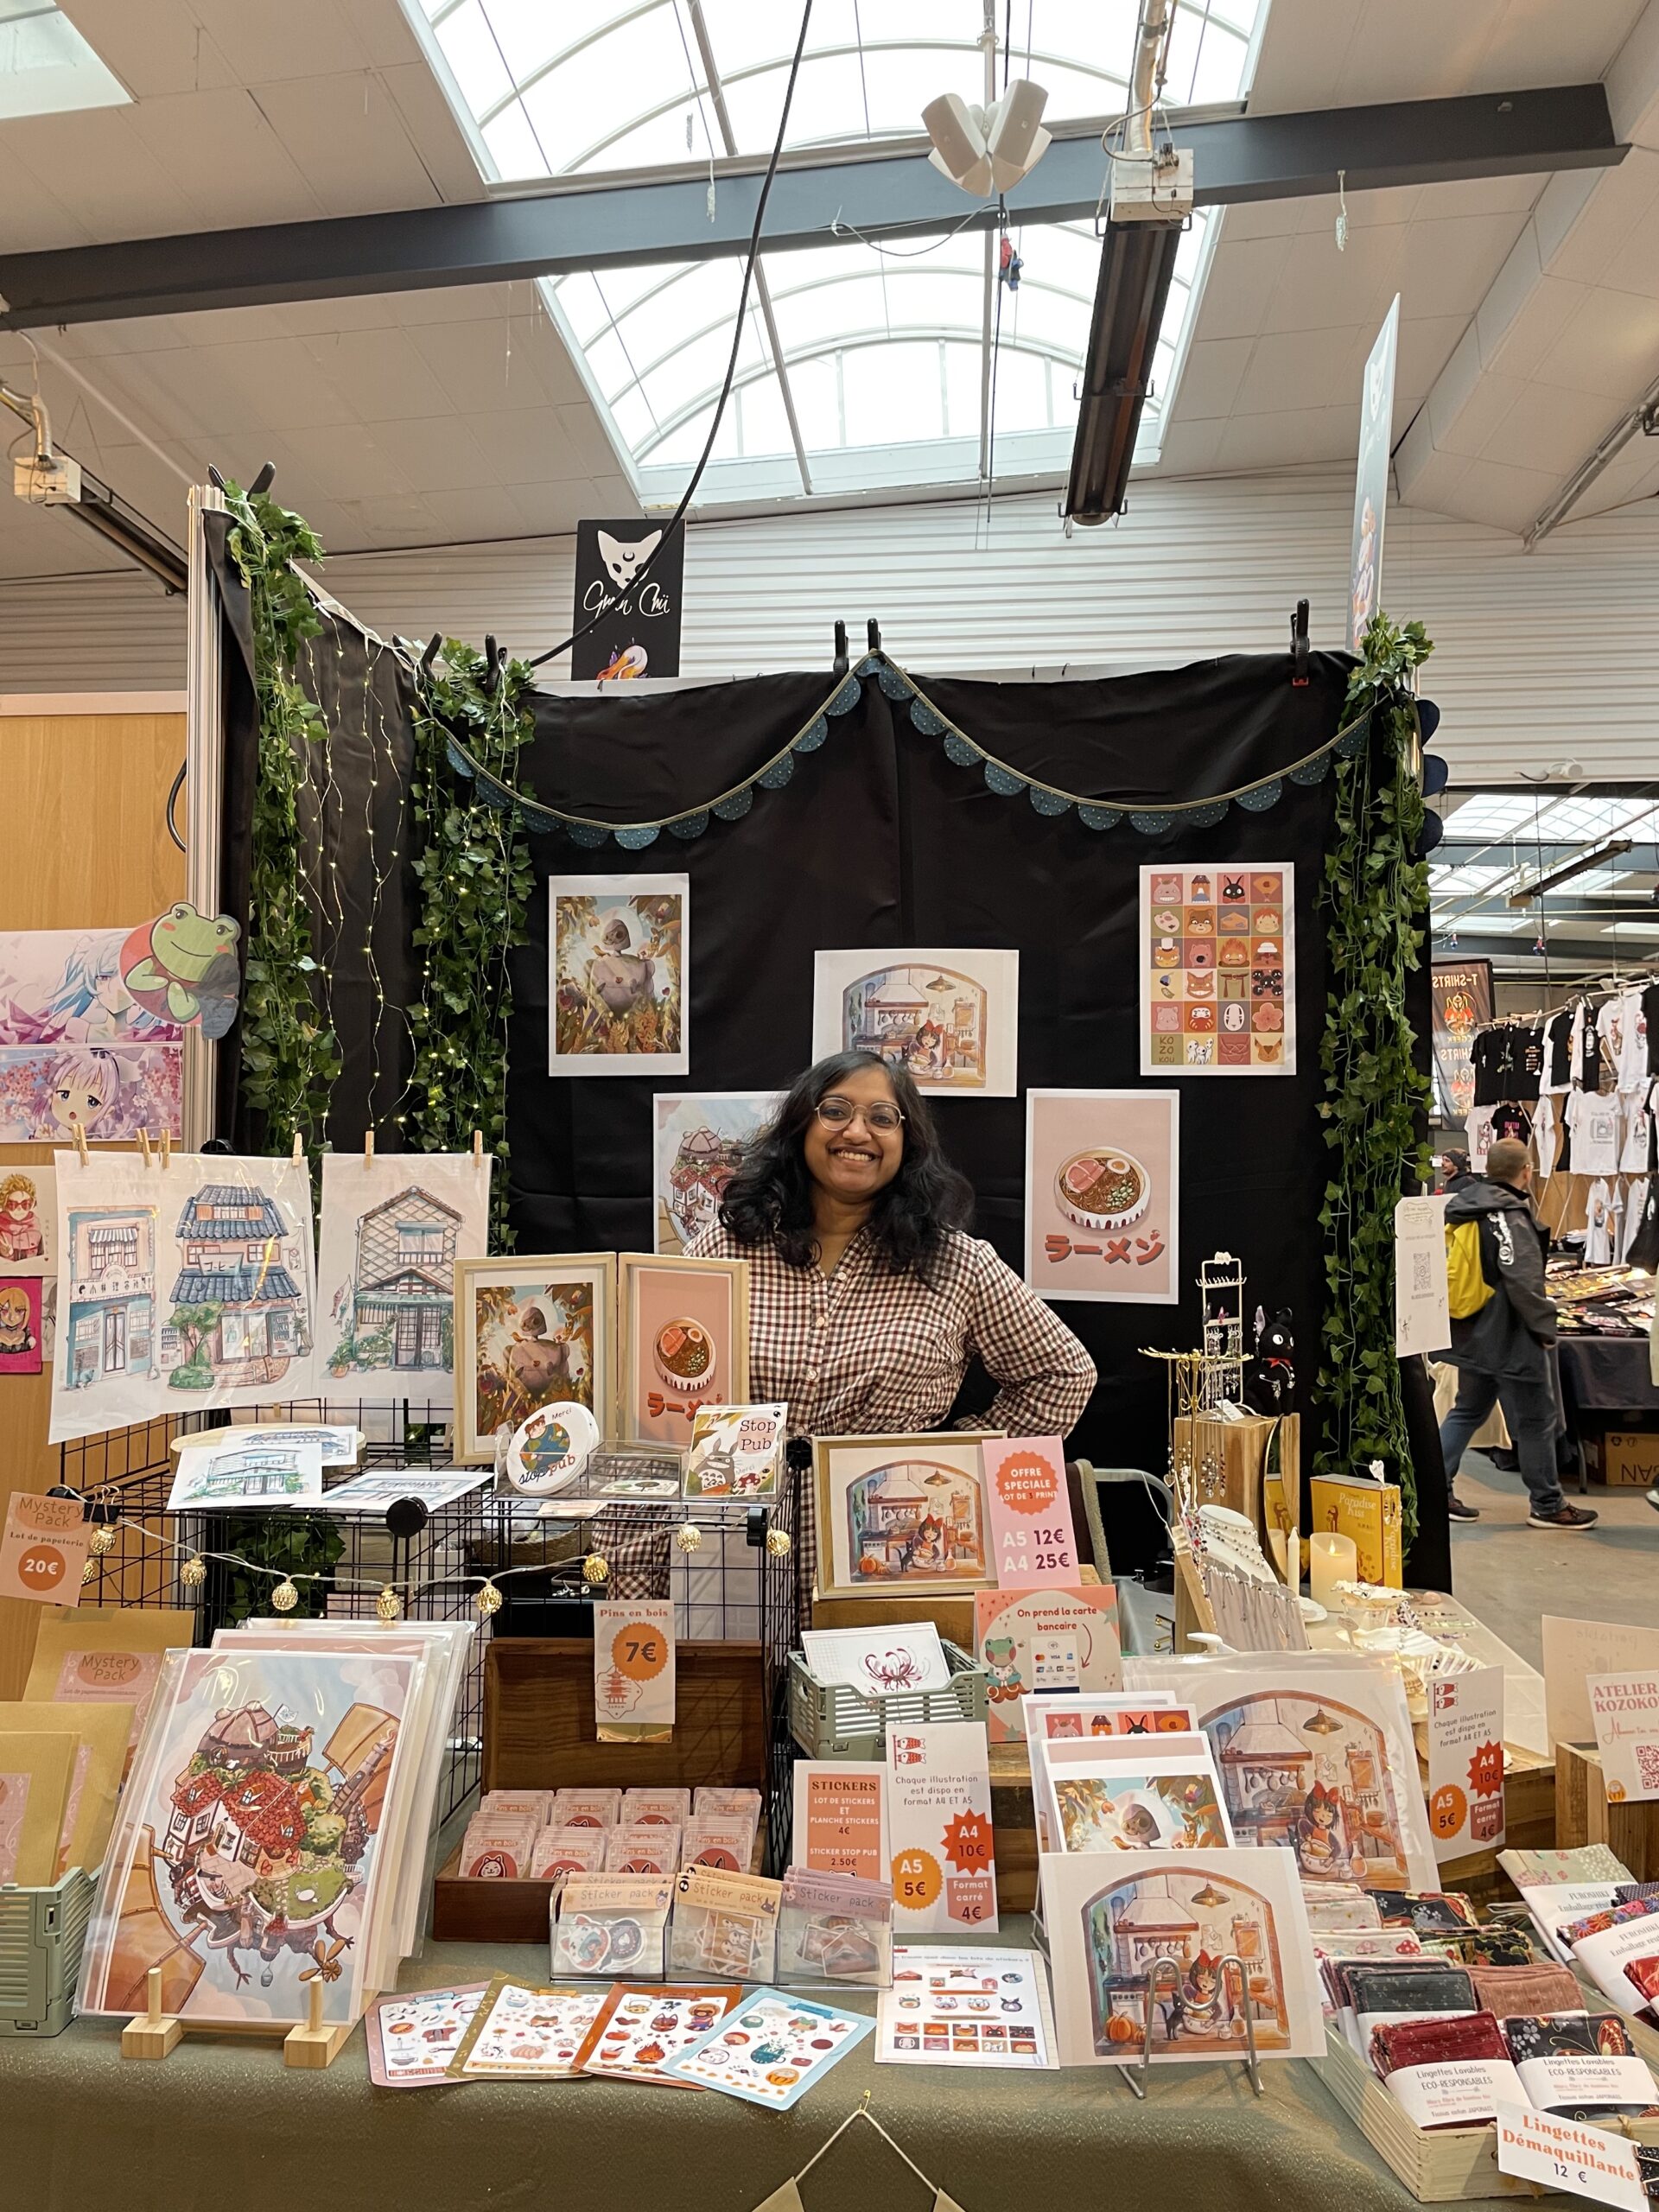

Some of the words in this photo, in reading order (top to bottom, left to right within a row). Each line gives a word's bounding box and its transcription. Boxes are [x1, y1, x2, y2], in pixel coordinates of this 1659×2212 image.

[551, 1407, 572, 1421] Merci
[740, 1420, 777, 1435] Stop
[741, 1438, 772, 1451] Pub
[518, 1468, 548, 1485] stop
[547, 1453, 576, 1477] pub
[1010, 1468, 1042, 1478] OFFRE
[1004, 1478, 1051, 1491] SPECIALE
[19, 1497, 84, 1516] Mystery
[1338, 1492, 1376, 1510] Paradise
[1347, 1504, 1365, 1518] Kiss
[35, 1512, 71, 1528] Pack
[10, 1531, 25, 1540] Lot
[28, 1533, 38, 1541] de
[41, 1536, 84, 1548] papeterie
[1002, 1531, 1027, 1548] A5
[1033, 1529, 1065, 1546] 12€
[24, 1559, 59, 1575] 20€
[1004, 1555, 1028, 1573] A4
[1035, 1552, 1070, 1570] 25€
[646, 1608, 668, 1618] bois
[1017, 1609, 1031, 1618] On
[1033, 1607, 1059, 1618] prend
[1062, 1607, 1071, 1616] la
[1072, 1606, 1097, 1615] carte
[1037, 1622, 1077, 1631] bancaire
[626, 1642, 657, 1662] 7€
[81, 1655, 139, 1671] Mystery
[93, 1668, 126, 1681] Pack
[1593, 1682, 1658, 1699] ATELIER
[1595, 1697, 1659, 1713] KOZOKO
[1434, 1719, 1458, 1730] Chaque
[1459, 1709, 1497, 1723] illustration
[1458, 1724, 1476, 1736] dispo
[1440, 1737, 1462, 1748] format
[1473, 1731, 1481, 1739] ET
[1484, 1728, 1491, 1737] A5
[1480, 1753, 1495, 1768] A4
[895, 1776, 926, 1785] Chaque
[930, 1775, 978, 1783] illustration
[1478, 1770, 1498, 1784] 10€
[812, 1781, 876, 1791] STICKERS
[928, 1786, 950, 1796] dispo
[904, 1797, 931, 1806] format
[1436, 1793, 1453, 1810] A5
[1474, 1800, 1500, 1814] Format
[1440, 1812, 1455, 1829] 5€
[1477, 1811, 1497, 1824] carré
[959, 1825, 978, 1838] A4
[1480, 1824, 1496, 1839] 4€
[696, 1836, 710, 1846] Pins
[712, 1836, 721, 1846] en
[722, 1836, 739, 1846] bois
[549, 1848, 563, 1857] Pins
[564, 1848, 573, 1857] en
[574, 1848, 589, 1857] bois
[959, 1844, 985, 1857] 10€
[830, 1858, 857, 1866] 2.50€
[900, 1859, 923, 1874] A5
[904, 1881, 926, 1897] 5€
[953, 1880, 988, 1890] Format
[581, 1889, 623, 1900] Sticker
[629, 1889, 654, 1899] pack
[694, 1882, 734, 1899] Sticker
[740, 1892, 763, 1903] pack
[800, 1887, 841, 1904] Sticker
[849, 1897, 874, 1908] pack
[956, 1892, 983, 1902] carré
[962, 1906, 982, 1920] 4€
[1543, 2058, 1580, 2067] Lingettes
[1416, 2068, 1453, 2079] Lingettes
[1453, 2065, 1486, 2075] Lavables
[1548, 2068, 1622, 2076] ECO-RESPONSABLES
[1421, 2075, 1493, 2090] ECO-RESPONSABLES
[1522, 2114, 1606, 2152] Lingettes
[1503, 2128, 1635, 2181] Démaquillante
[1554, 2163, 1568, 2177] 12
[1578, 2171, 1587, 2183] €
